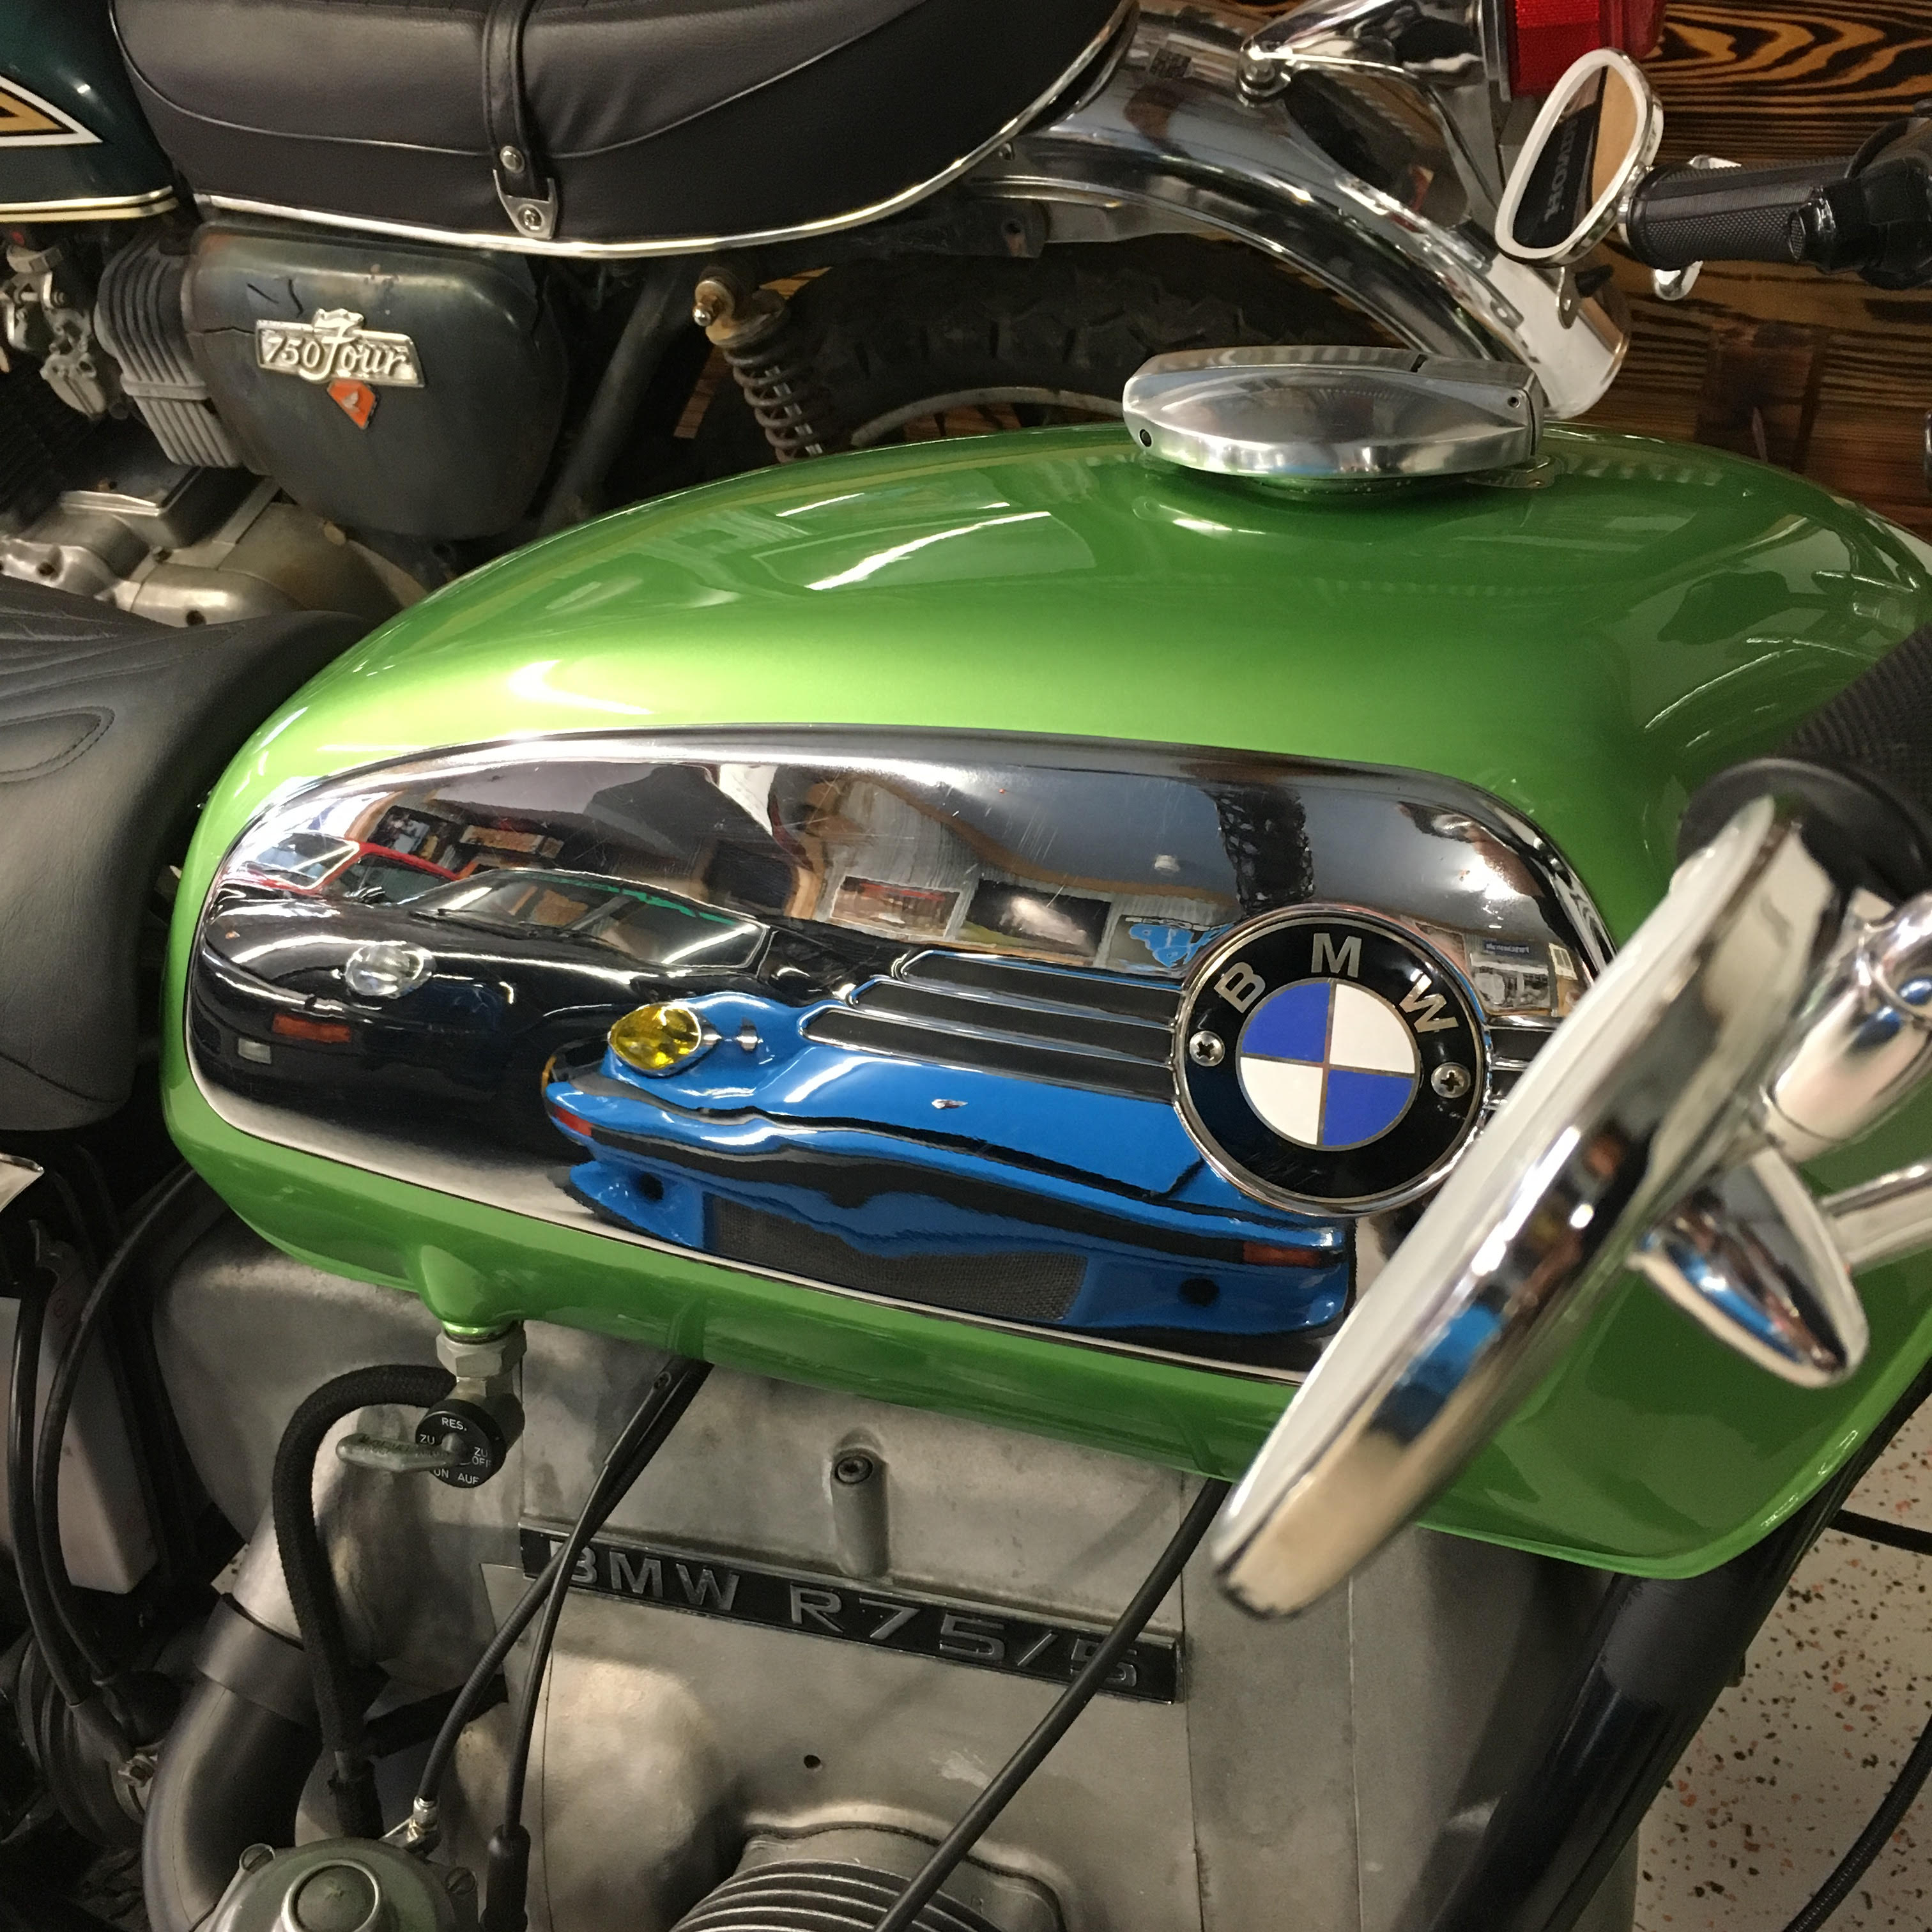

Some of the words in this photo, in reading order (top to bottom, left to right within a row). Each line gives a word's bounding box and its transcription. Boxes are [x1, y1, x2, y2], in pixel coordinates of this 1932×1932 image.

[1213, 932, 1459, 1034] BMW
[441, 1417, 467, 1431] RES.
[420, 1434, 435, 1445] ZU
[474, 1446, 488, 1457] ZU
[457, 1473, 480, 1485] AUF
